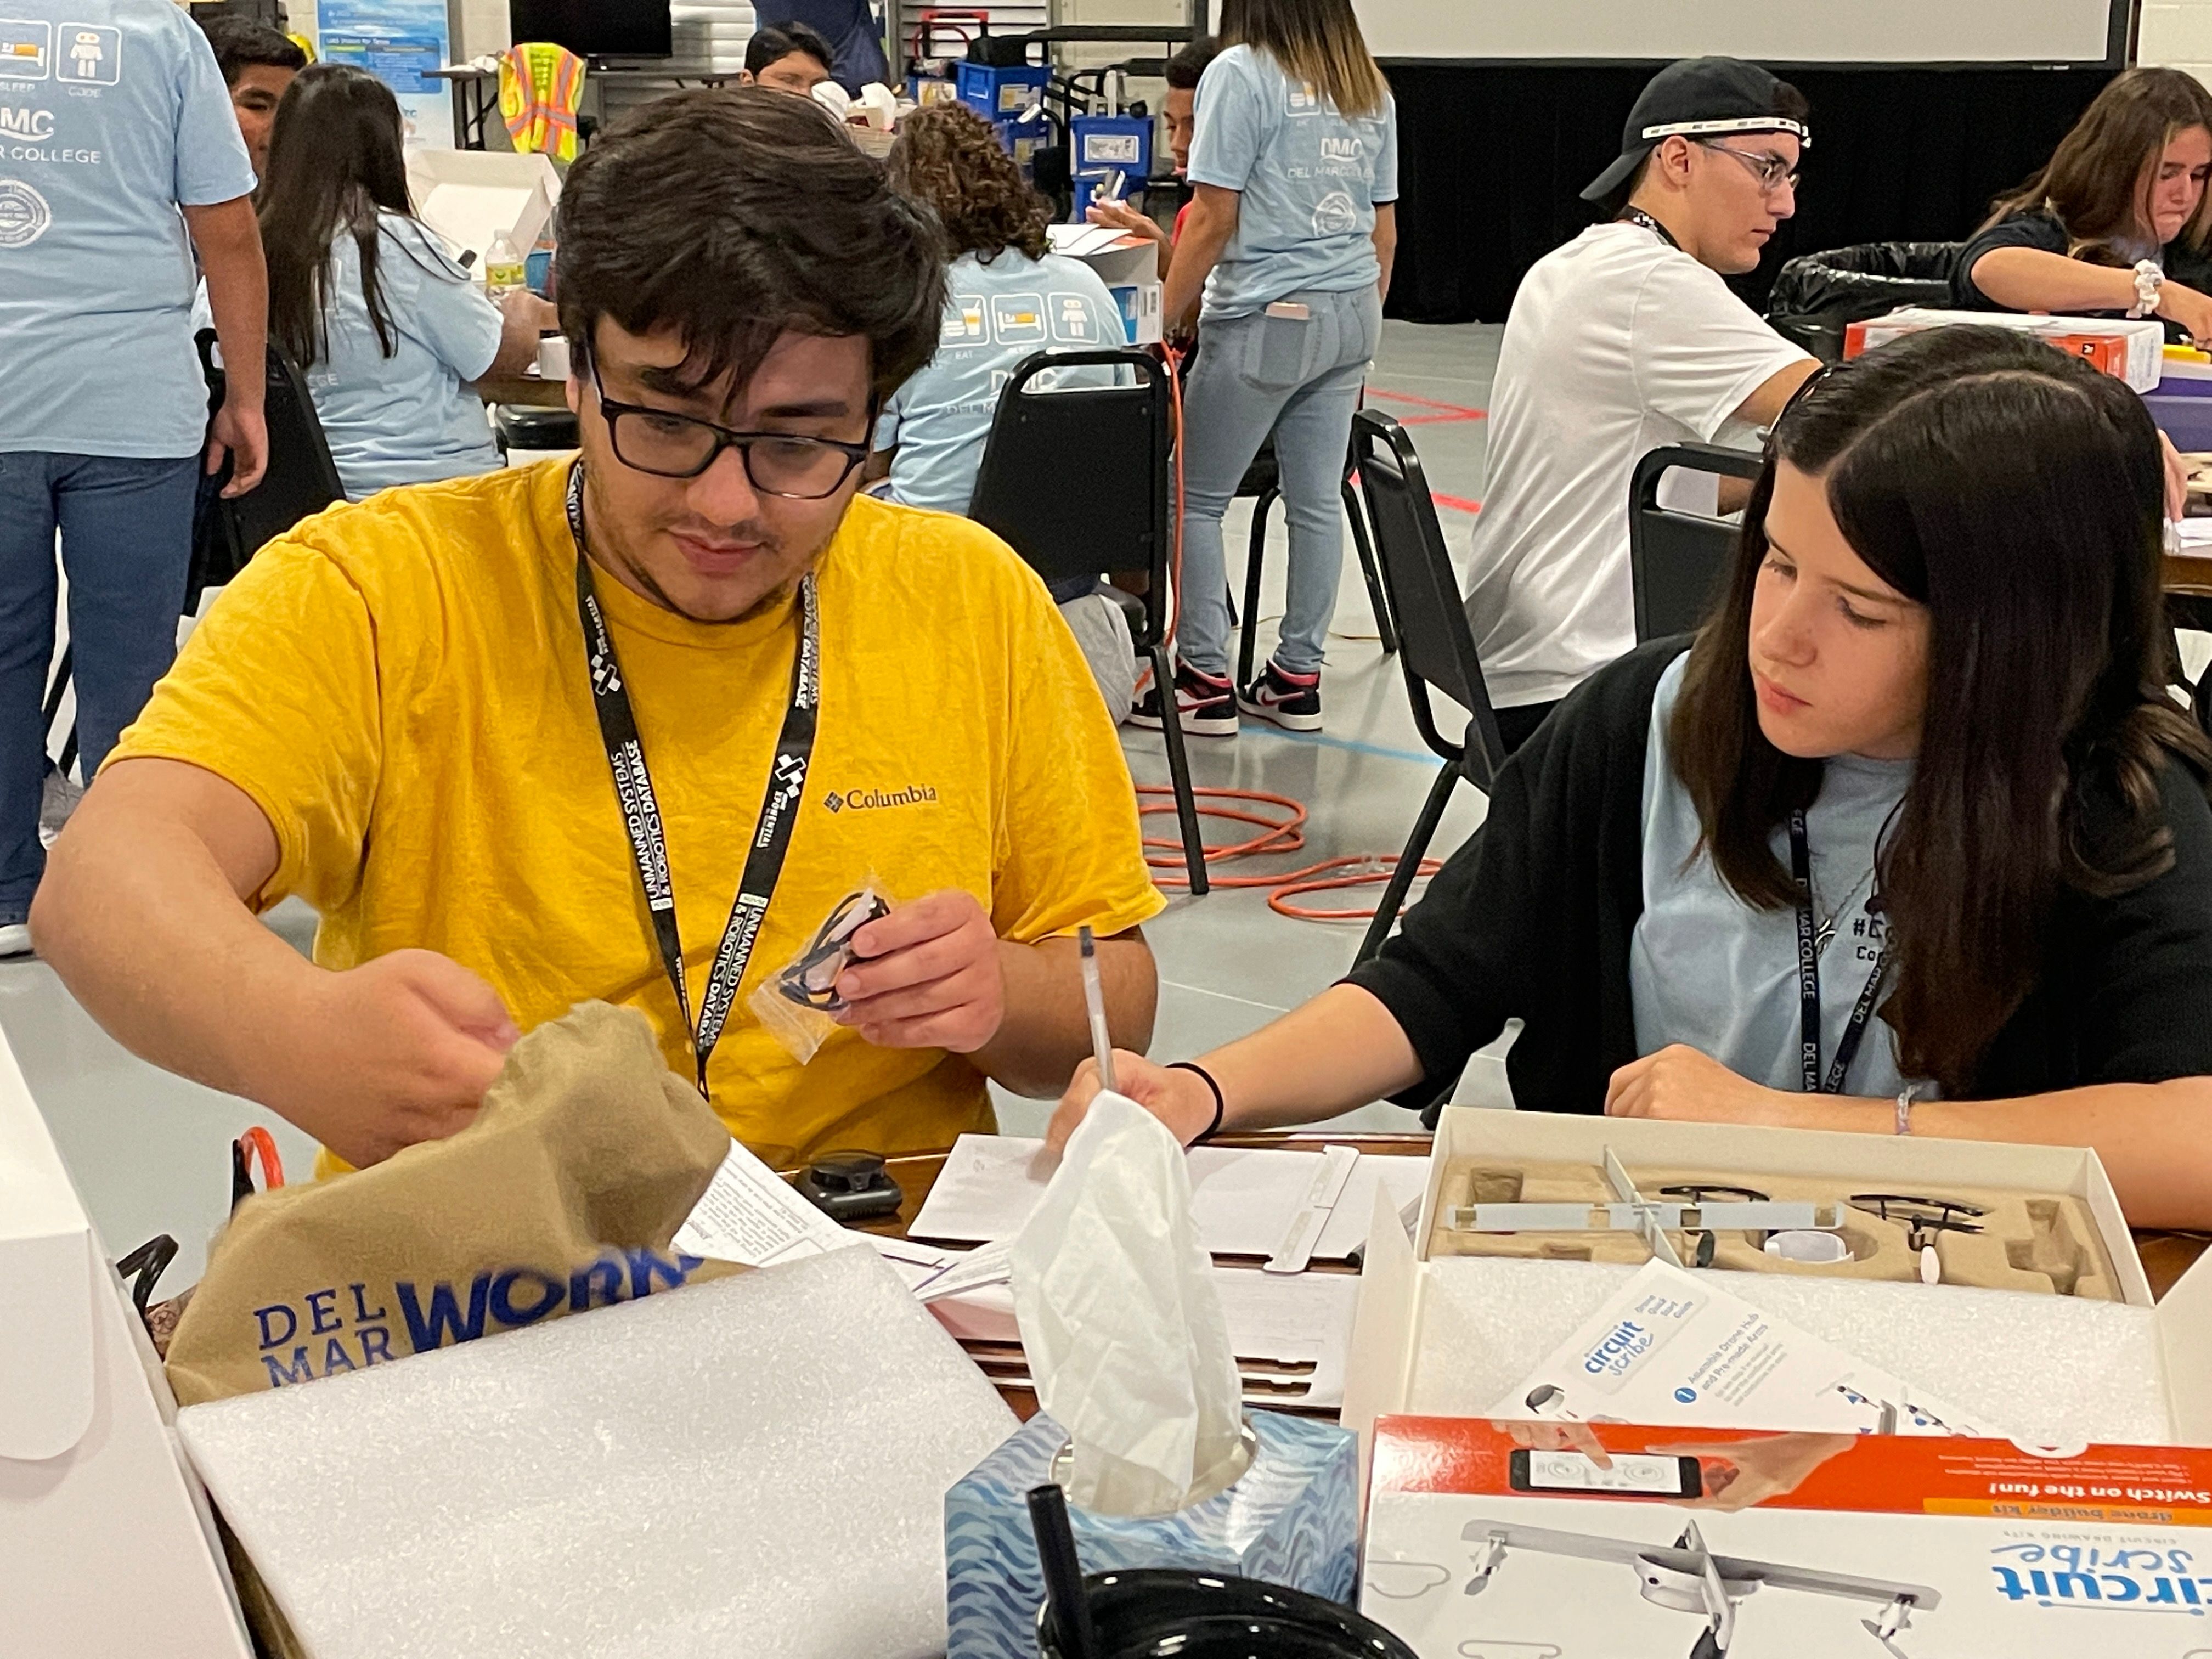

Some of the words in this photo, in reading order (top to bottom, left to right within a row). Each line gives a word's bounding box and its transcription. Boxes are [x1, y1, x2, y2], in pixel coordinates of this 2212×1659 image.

[68, 86, 102, 98] CODE
[0, 107, 54, 135] MC
[11, 146, 101, 164] COLLEGE
[1321, 138, 1363, 157] DMC
[1287, 166, 1311, 179] DEL
[955, 351, 973, 359] EAT
[991, 368, 1055, 391] DC
[795, 638, 811, 709] DATABASE
[610, 752, 638, 815] SYSTEMS
[625, 739, 656, 814] DATABASE
[847, 783, 936, 809] Columbia
[628, 815, 658, 899] UNMANNED
[645, 813, 668, 883] ROBOTICS
[713, 916, 744, 980] ROBOTICS
[727, 907, 765, 986] UNMANNED
[1800, 939, 1816, 1000] COLLEGE
[1803, 1043, 1816, 1069] DEL
[1804, 1071, 1817, 1091] MA
[254, 1283, 387, 1351] DEL
[1740, 1313, 1759, 1330] Hub
[261, 1326, 395, 1388] MAR
[1585, 1321, 1644, 1374] circuit
[1608, 1333, 1654, 1376] scribe
[1989, 1482, 2040, 1497] fun!
[2044, 1484, 2086, 1498] the
[2090, 1486, 2122, 1498] on
[2126, 1487, 2211, 1504] Switch
[1993, 1505, 2022, 1516] kit
[2028, 1505, 2103, 1519] builder
[2110, 1511, 2173, 1521] drone
[1990, 1543, 2194, 1574] scribe
